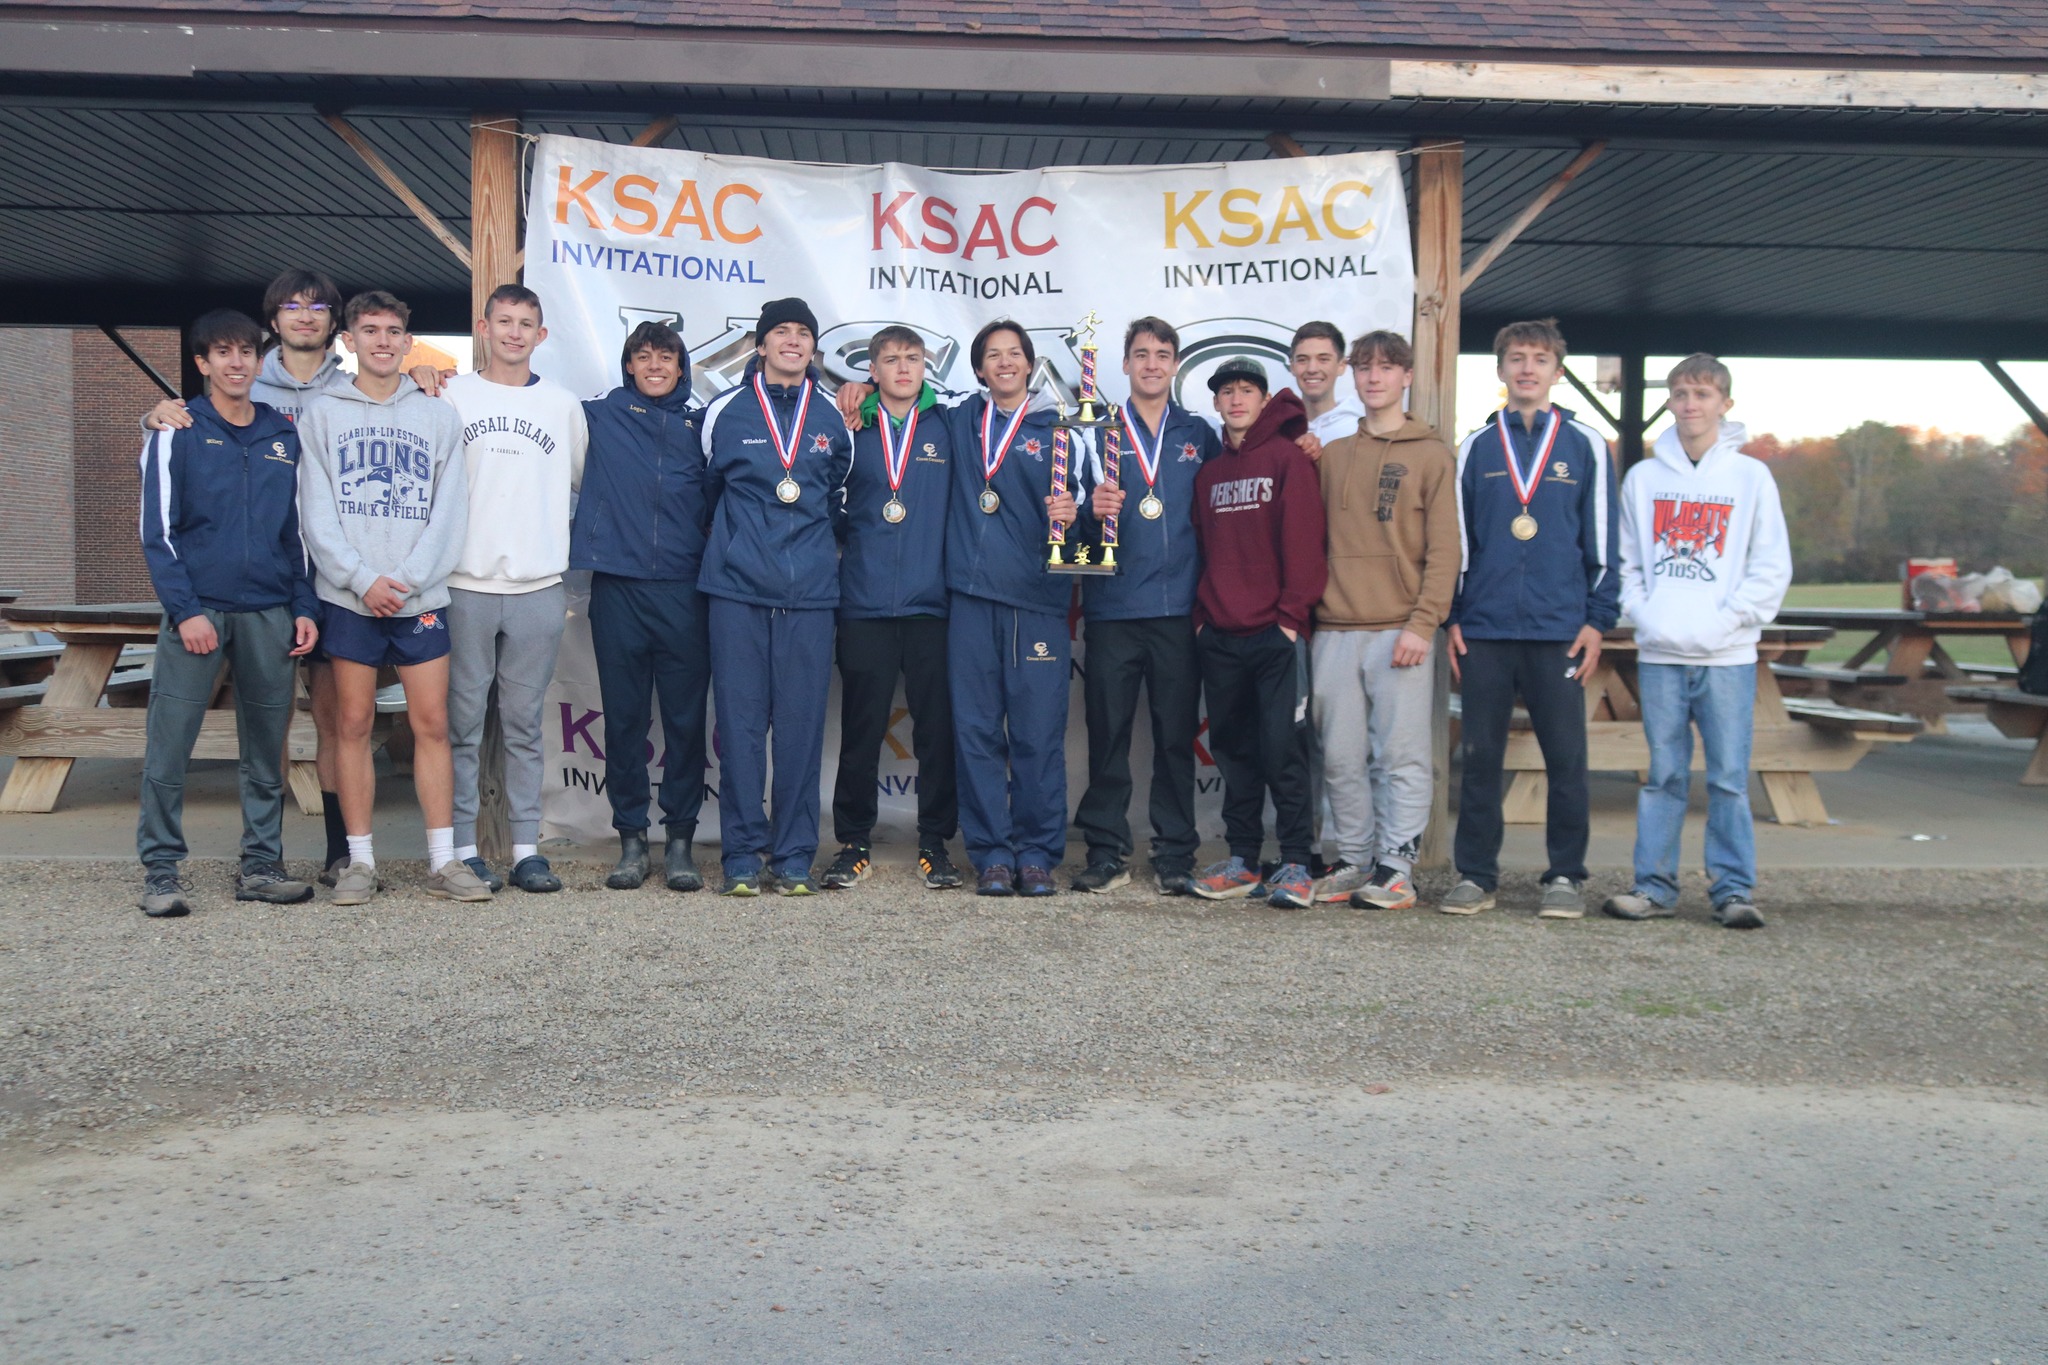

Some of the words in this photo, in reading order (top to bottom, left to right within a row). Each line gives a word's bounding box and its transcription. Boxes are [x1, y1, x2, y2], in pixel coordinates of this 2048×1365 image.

[553, 165, 764, 245] KSAC
[871, 190, 1059, 262] KSAC
[1162, 180, 1377, 250] KSAC
[551, 239, 766, 284] INVITATIONAL
[869, 265, 1064, 300] INVITATIONAL
[1164, 254, 1379, 289] INVITATIONAL
[629, 404, 647, 414] Logan
[513, 417, 556, 455] ISLAND
[338, 438, 431, 483] LIONS
[339, 499, 379, 517] TRACK
[382, 505, 389, 518] &
[394, 505, 429, 521] FIELD
[1653, 499, 1735, 559] WILDCATS
